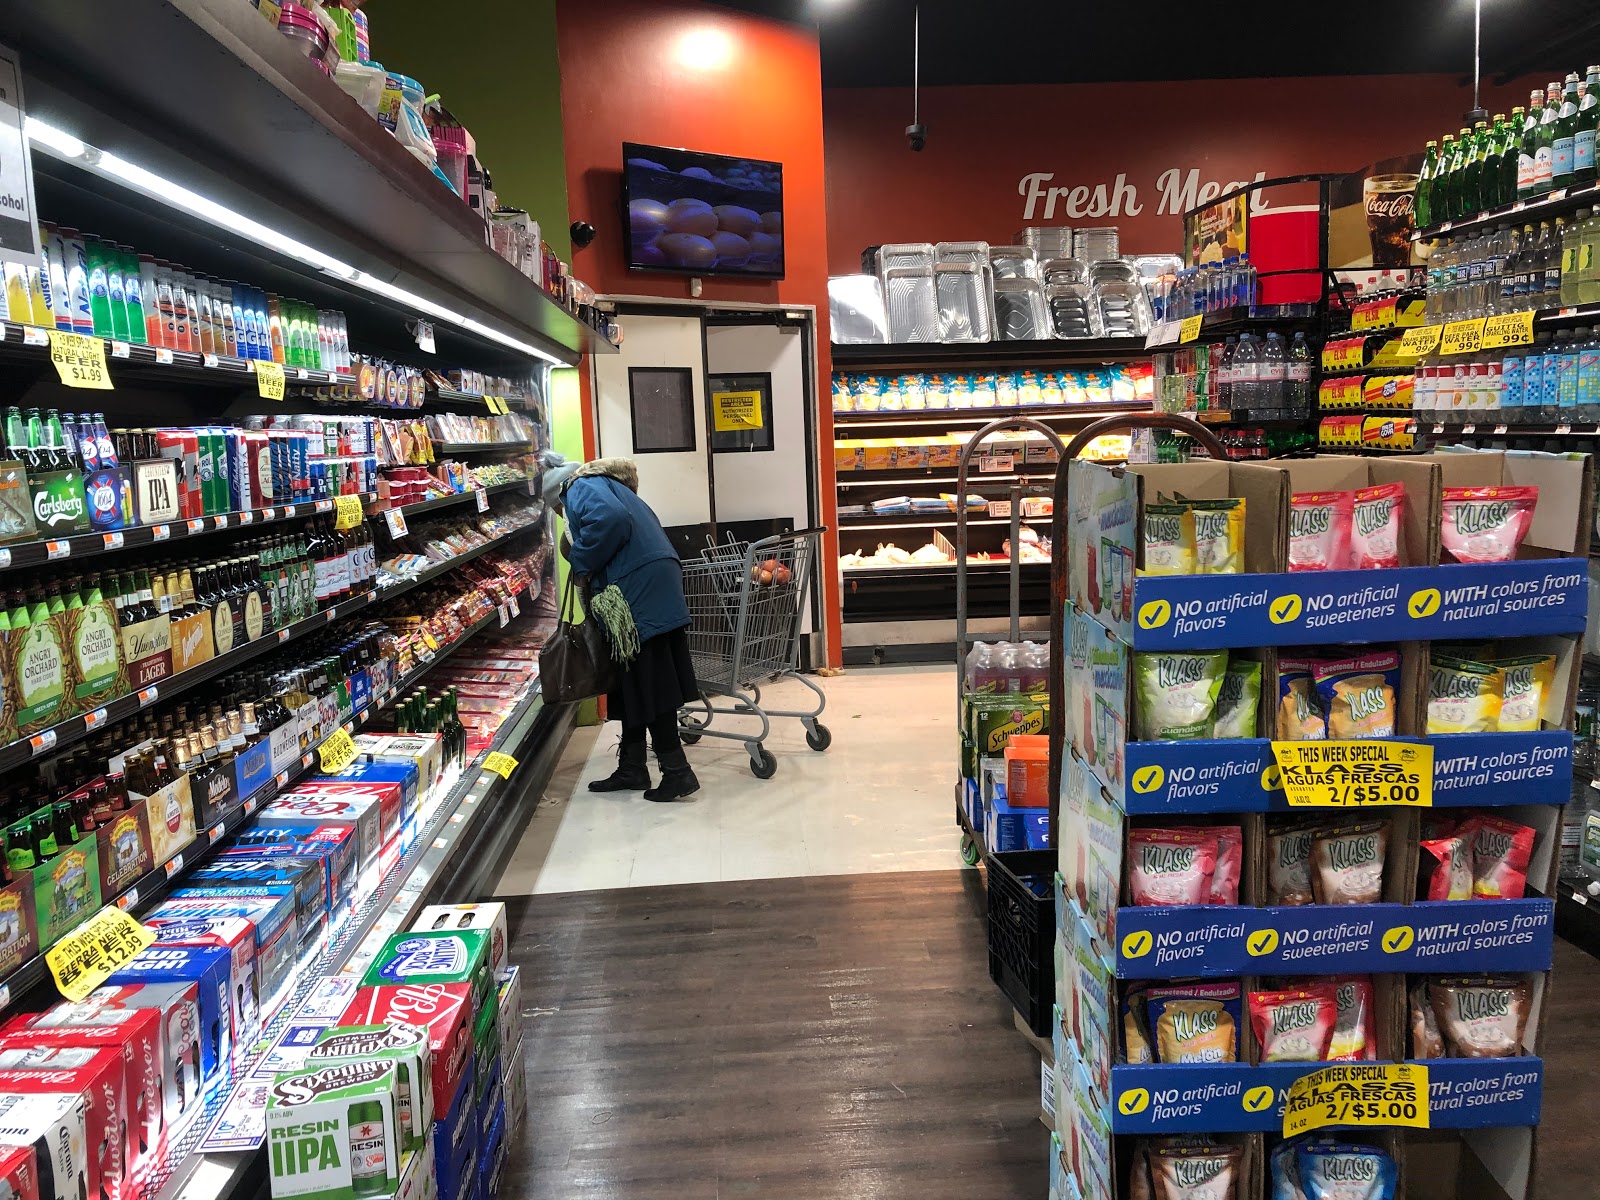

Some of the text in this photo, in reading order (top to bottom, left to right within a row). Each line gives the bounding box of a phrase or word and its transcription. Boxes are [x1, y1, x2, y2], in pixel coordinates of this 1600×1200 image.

[1018, 172, 1143, 220] Fresh
[1445, 336, 1480, 344] WATER
[53, 353, 102, 369] BEER
[82, 350, 100, 360] LIGHT
[72, 367, 102, 381] $1.99
[259, 378, 283, 388] BEER
[34, 490, 83, 522] Carlsberg
[148, 477, 171, 512] IPA
[1196, 513, 1228, 539] LASS
[1456, 502, 1510, 535] KLASS
[1306, 583, 1400, 612] NO artificial
[1443, 573, 1581, 605] WITH colors from
[1174, 589, 1268, 619] NO artificial
[1305, 602, 1396, 629] sweeteners
[1442, 591, 1567, 622] natural sources
[85, 629, 107, 645] ANGRY
[1173, 614, 1227, 638] flavors
[29, 648, 51, 665] ANGRY
[81, 638, 112, 656] ORCHARD
[88, 650, 109, 662] HARD CIDER
[24, 658, 58, 679] ORCHARD
[139, 662, 166, 684] LAGER
[1159, 656, 1206, 688] KLASS
[1318, 656, 1394, 675] Sweetened Endulzado
[31, 676, 42, 686] HARD
[1429, 669, 1480, 699] KLASS
[992, 717, 1040, 748] Schweppes
[273, 734, 298, 759] BUDWEISER
[336, 748, 354, 767] $7.99
[1298, 747, 1319, 763] THIS
[1321, 746, 1348, 762] WEEK
[1350, 746, 1390, 762] SPECIAL
[1168, 758, 1261, 784] NO artificial
[1281, 763, 1404, 776] KLASS
[1434, 755, 1478, 776] WITH
[1480, 751, 1527, 769] colors
[1529, 745, 1568, 766] from
[1287, 773, 1420, 785] AGUAS FRESCAS
[1432, 763, 1554, 791] natural sources
[1166, 782, 1219, 802] flavors
[1327, 786, 1420, 806] 2/$5.00
[1143, 845, 1192, 874] KLASS
[1329, 836, 1376, 872] KLASS
[106, 851, 148, 887] CELEBRATION
[51, 890, 94, 928] PALE ALE
[1156, 922, 1246, 949] NO artificial
[1282, 920, 1374, 946] NO artificial
[1417, 913, 1548, 942] WITH colors from
[58, 946, 100, 979] SIERRA
[98, 918, 131, 950] NEVADA
[97, 935, 143, 974] $12.99
[426, 939, 457, 970] ROLLING
[1155, 944, 1205, 967] flavors
[1281, 936, 1369, 961] sweeteners
[1415, 930, 1534, 957] natural sources
[124, 958, 191, 971] IGHT
[402, 951, 433, 971] ROCK
[218, 980, 231, 1029] BUD
[1153, 987, 1235, 997] Sweetened Endulzado
[1273, 1001, 1316, 1036] KLASS
[1458, 991, 1509, 1022] KLASS
[1173, 1010, 1218, 1042] KLASS
[325, 1073, 376, 1090] BREWERY
[1307, 1066, 1388, 1089] THIS WEEK SPECIAL
[1455, 1071, 1538, 1093] colors from
[1153, 1081, 1242, 1105] NO artificial
[1289, 1091, 1417, 1114] AGUAS FRESCAS
[1290, 1082, 1416, 1105] KLASS
[1429, 1088, 1525, 1111] tural sources
[1151, 1103, 1202, 1123] flavors
[1325, 1103, 1417, 1121] 2/$5.00
[271, 1119, 339, 1140] RESIN
[58, 1124, 74, 1183] Corona
[272, 1134, 342, 1178] IIPA
[351, 1139, 384, 1152] RESIN
[1175, 1159, 1222, 1187] KLASS
[1323, 1157, 1375, 1182] KLASS
